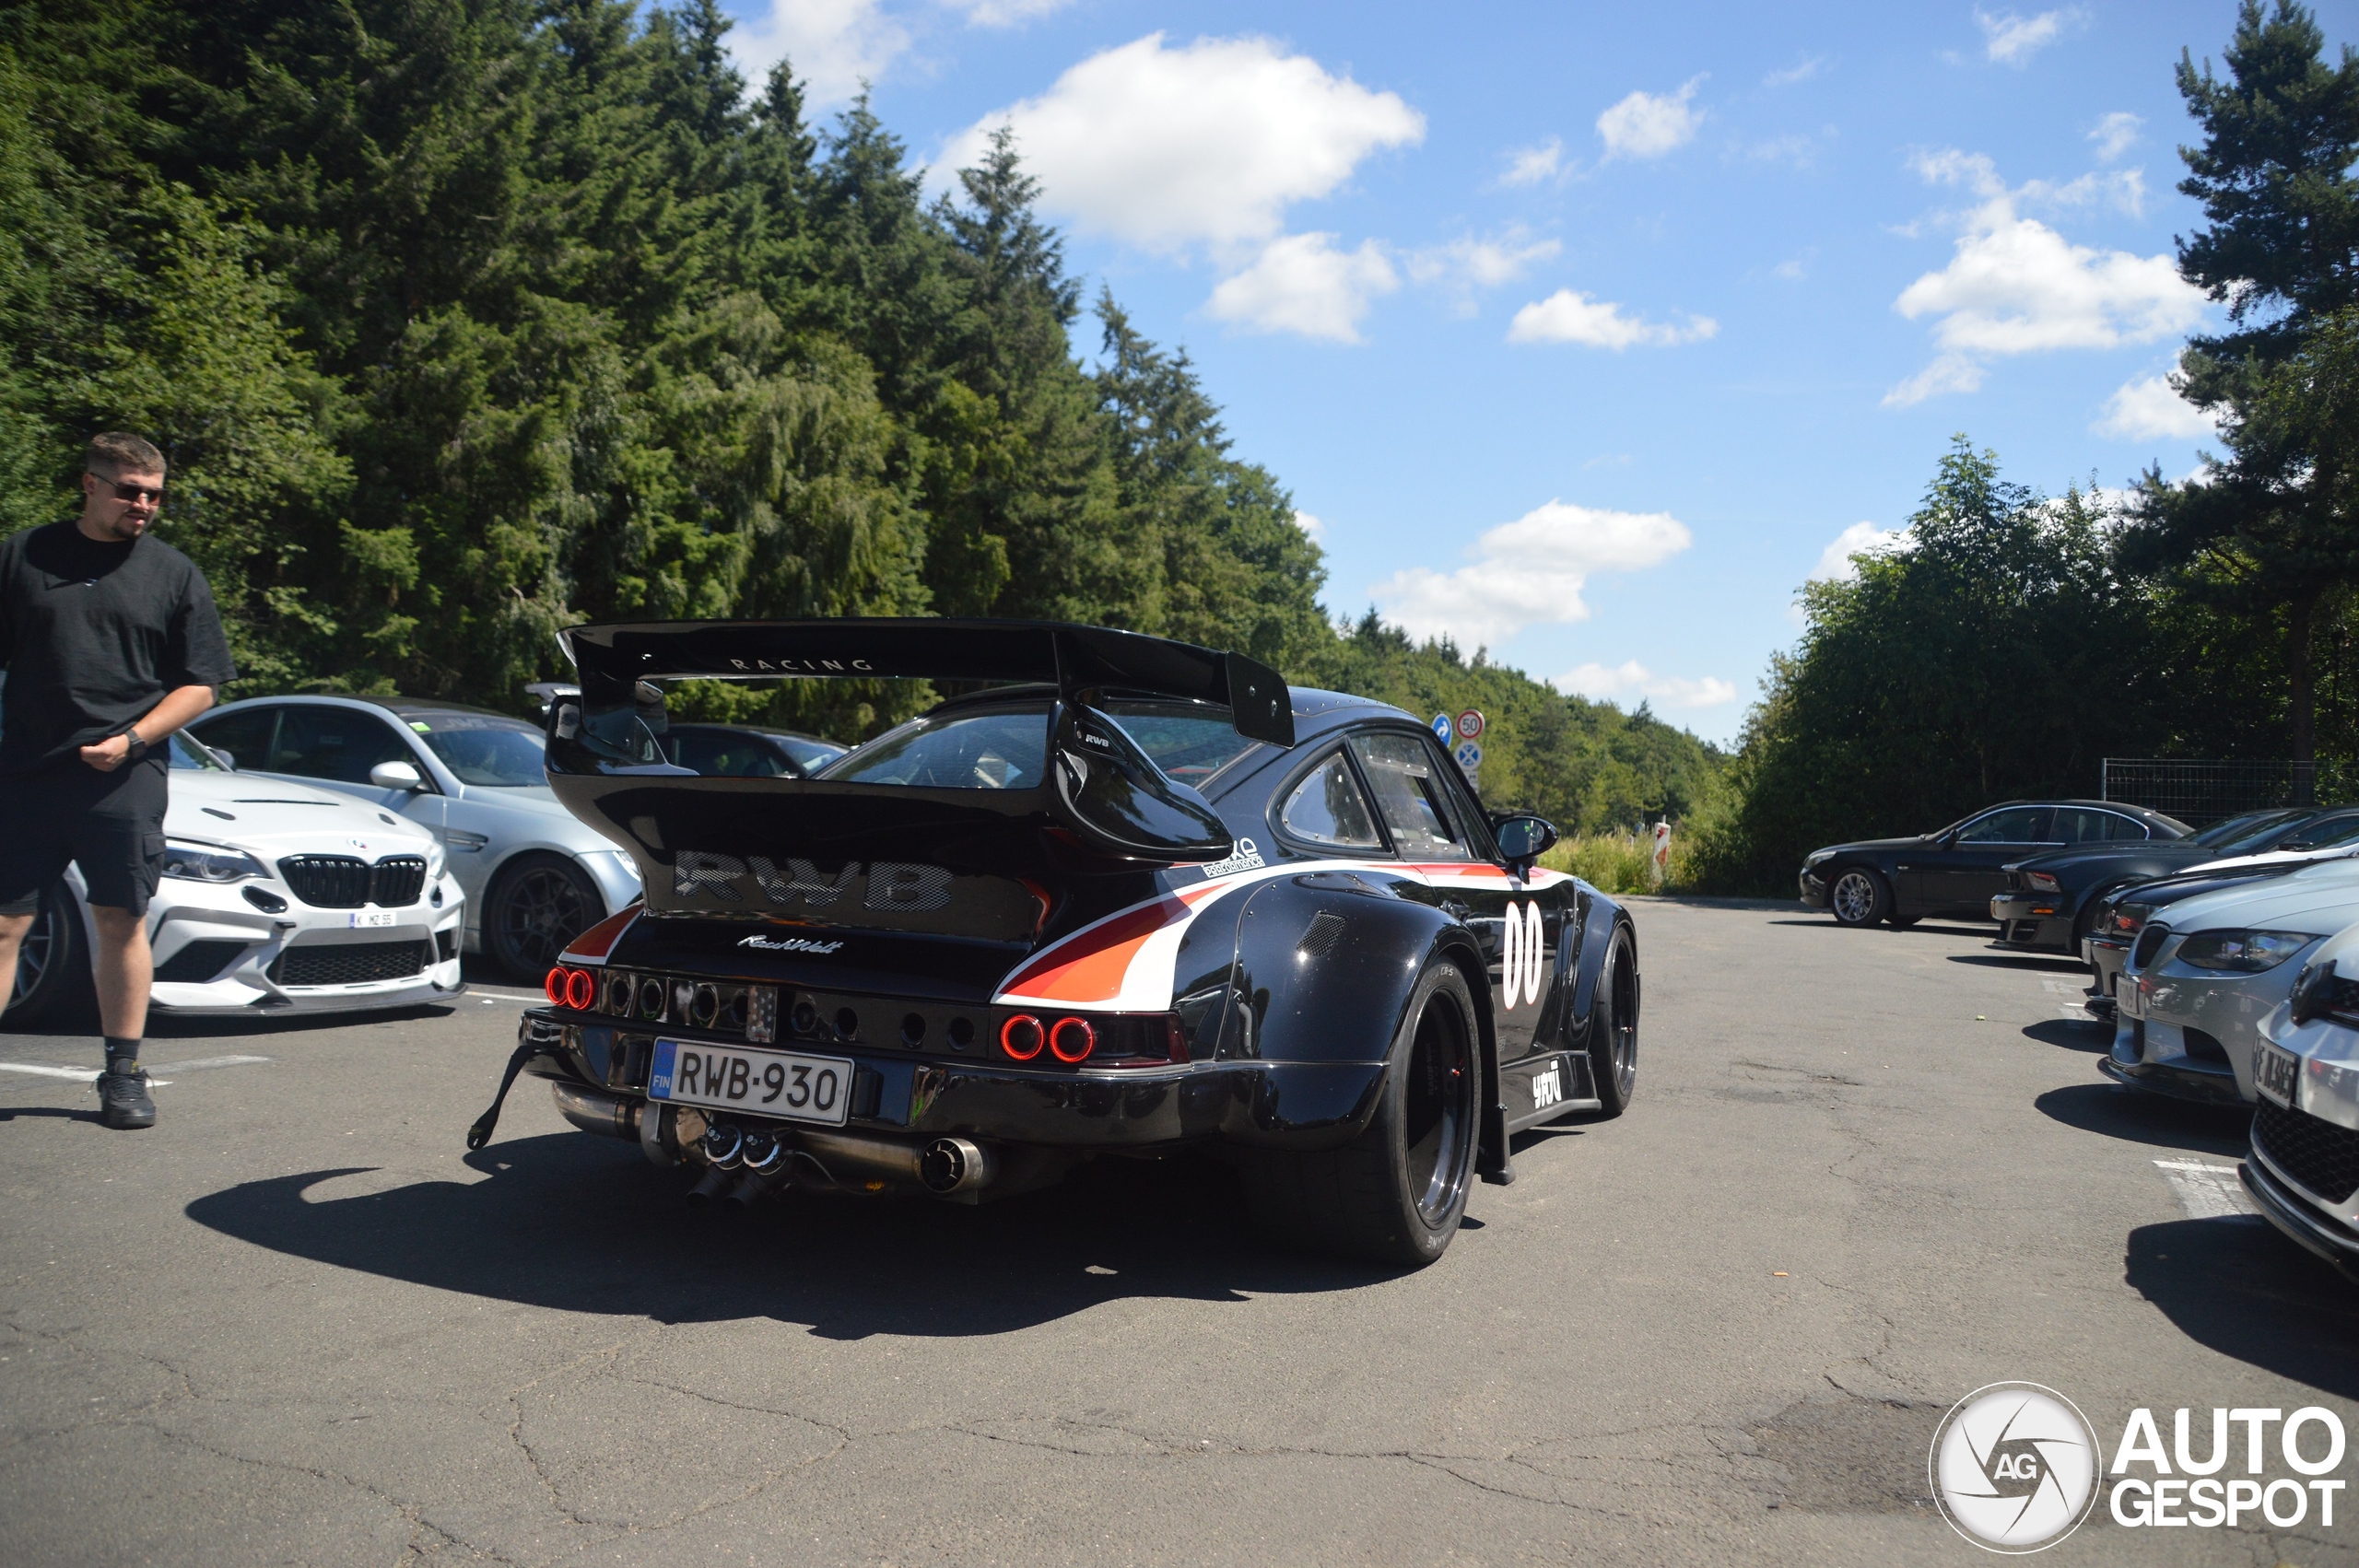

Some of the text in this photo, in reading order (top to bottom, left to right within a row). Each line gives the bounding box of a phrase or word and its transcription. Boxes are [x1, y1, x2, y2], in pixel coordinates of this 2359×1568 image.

[730, 659, 874, 671] RACING
[1462, 719, 1478, 731] 50
[1086, 734, 1109, 747] RWB
[674, 850, 955, 911] RWB
[1503, 899, 1543, 1011] 00
[652, 1075, 670, 1089] FIN
[678, 1052, 838, 1111] RWB-930
